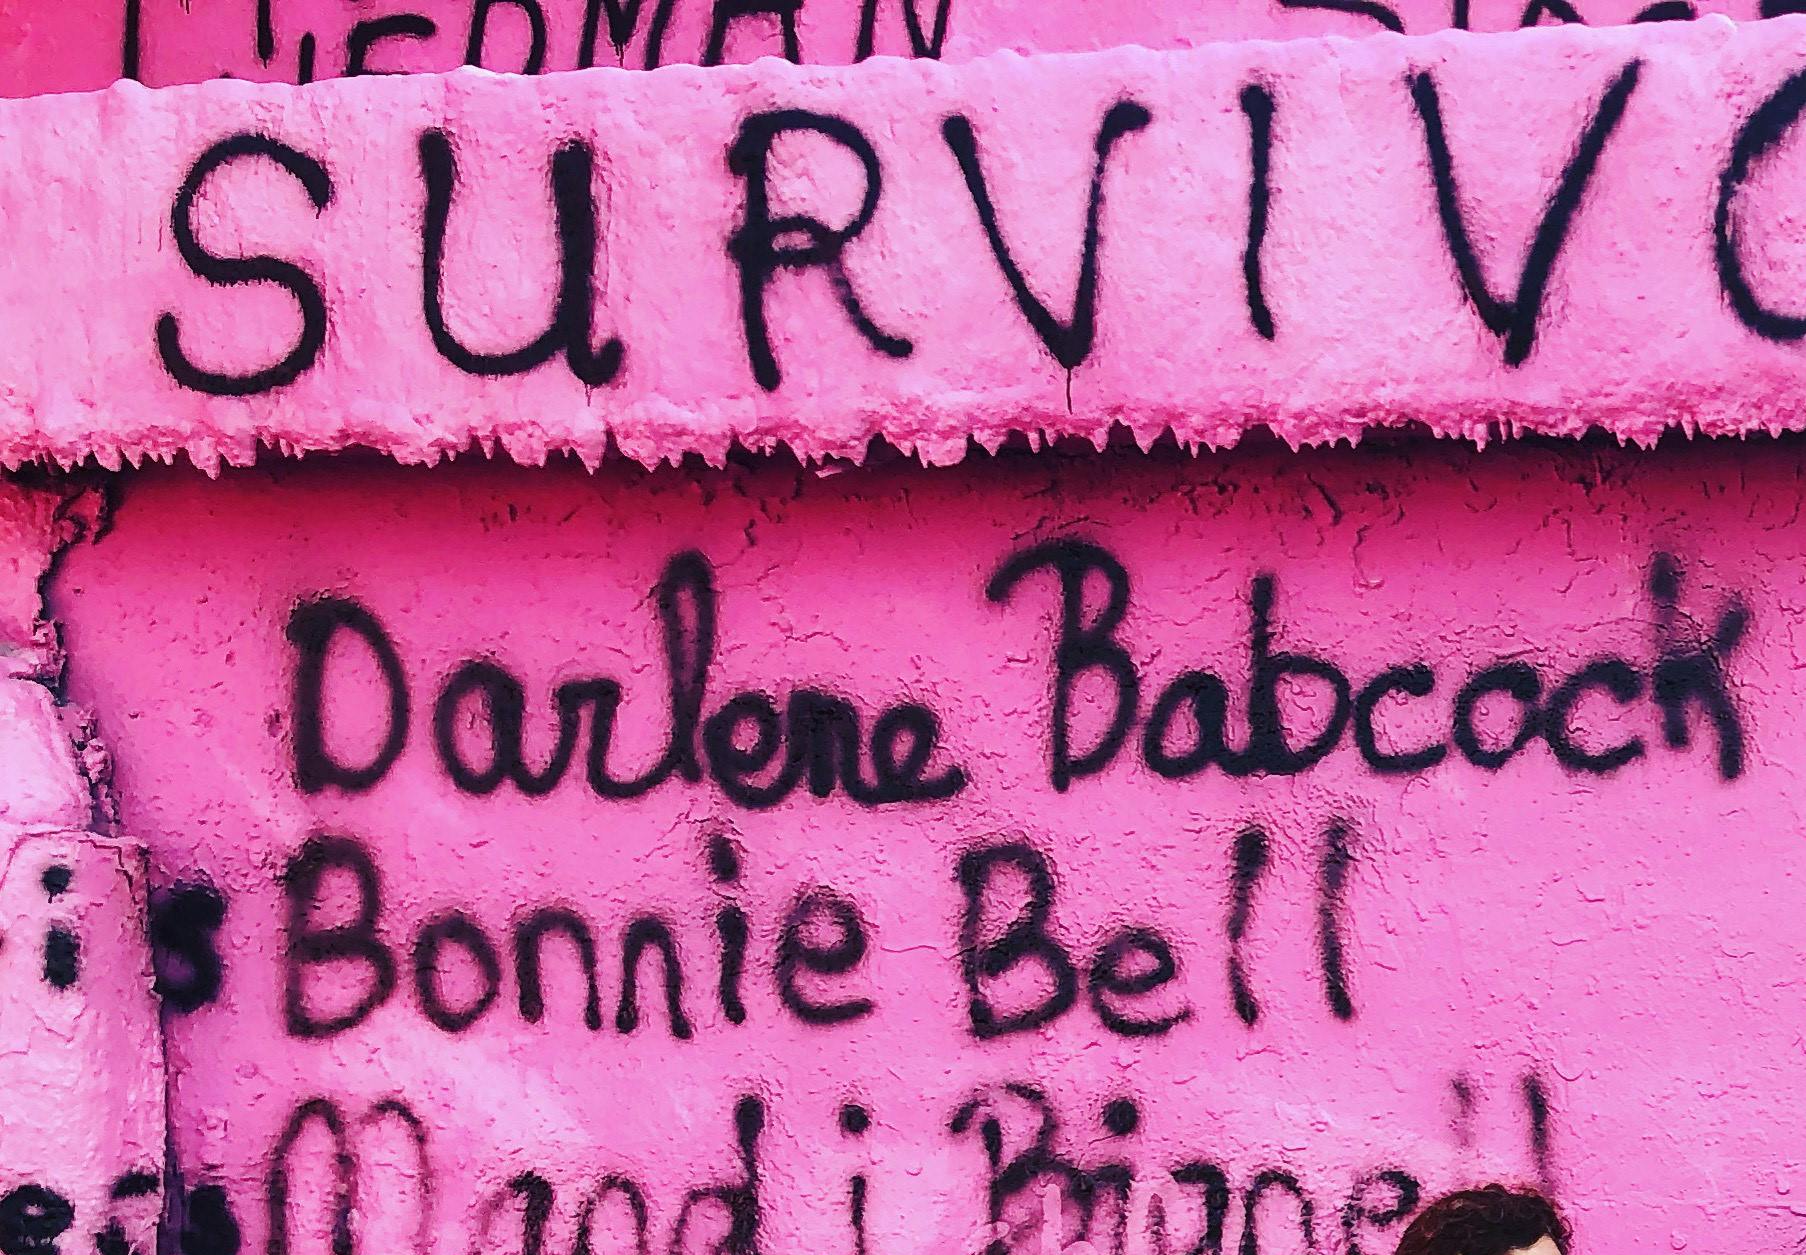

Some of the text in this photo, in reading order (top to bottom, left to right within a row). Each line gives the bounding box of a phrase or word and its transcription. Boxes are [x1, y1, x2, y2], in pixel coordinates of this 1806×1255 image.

[286, 532, 1749, 809] Darlene Babcock
[283, 824, 1351, 1039] Bonnie Bell
